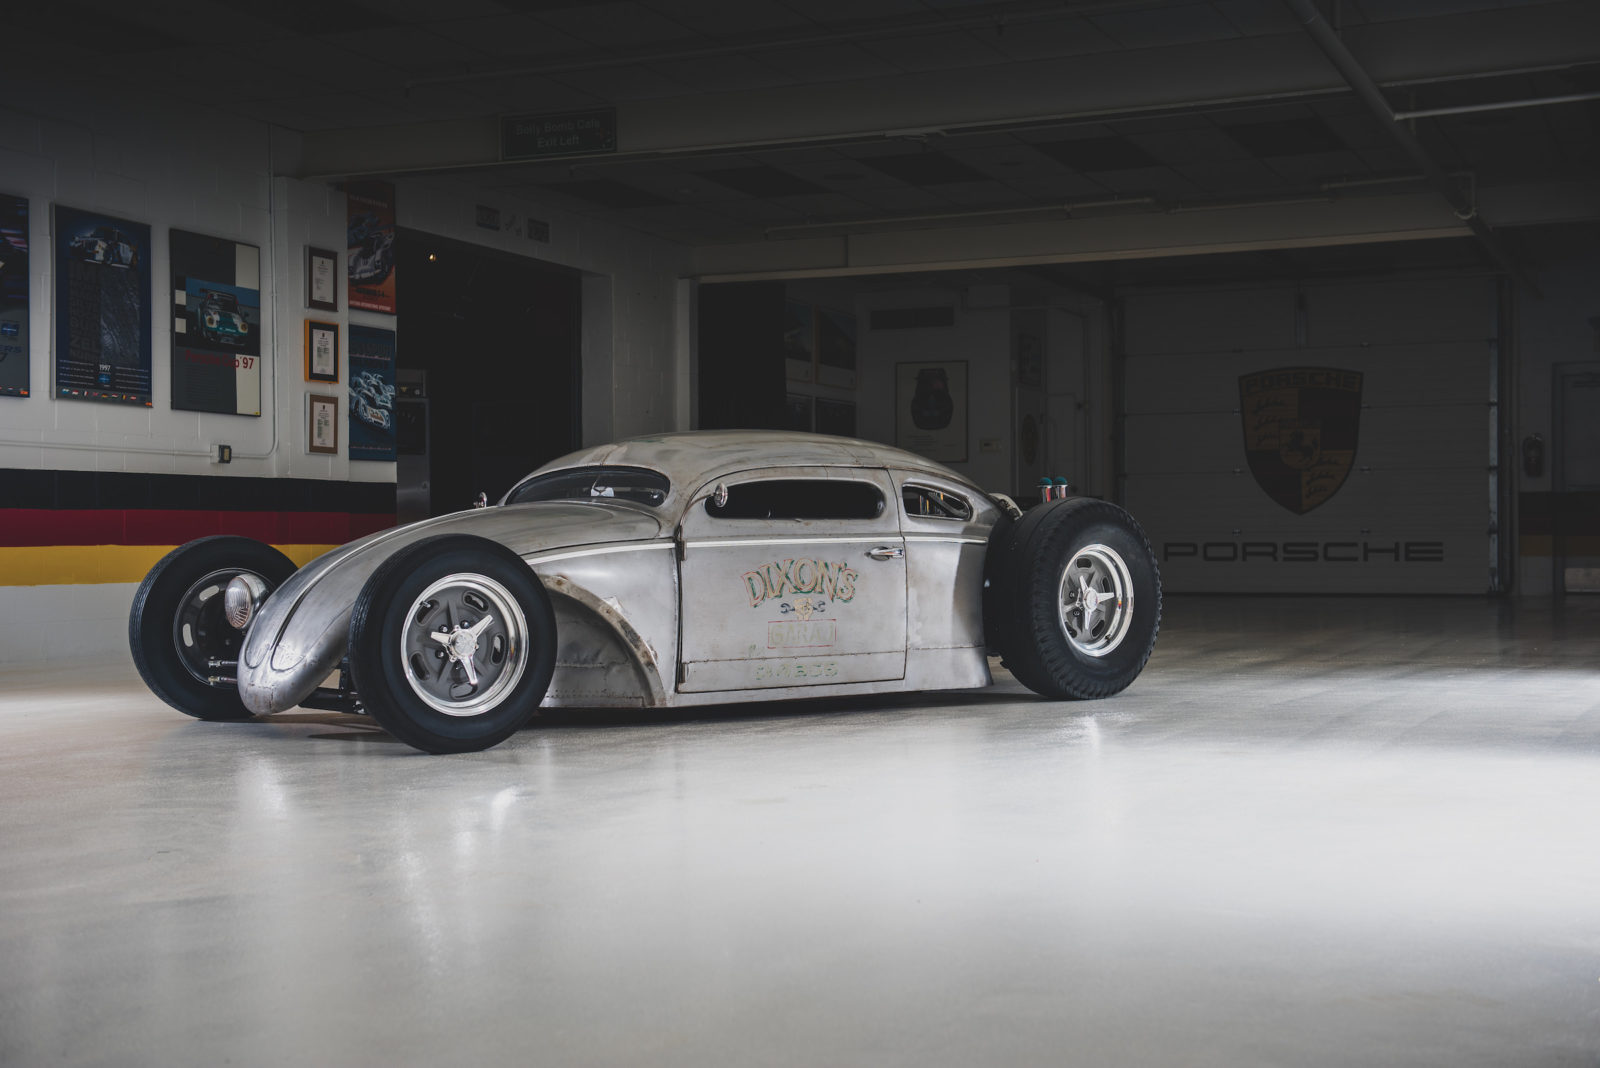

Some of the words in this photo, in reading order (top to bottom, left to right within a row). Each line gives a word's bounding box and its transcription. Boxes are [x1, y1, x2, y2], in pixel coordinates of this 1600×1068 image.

[1245, 371, 1359, 390] PORSCHE
[1163, 541, 1444, 562] PORSCHE
[740, 558, 859, 608] DIXON'S
